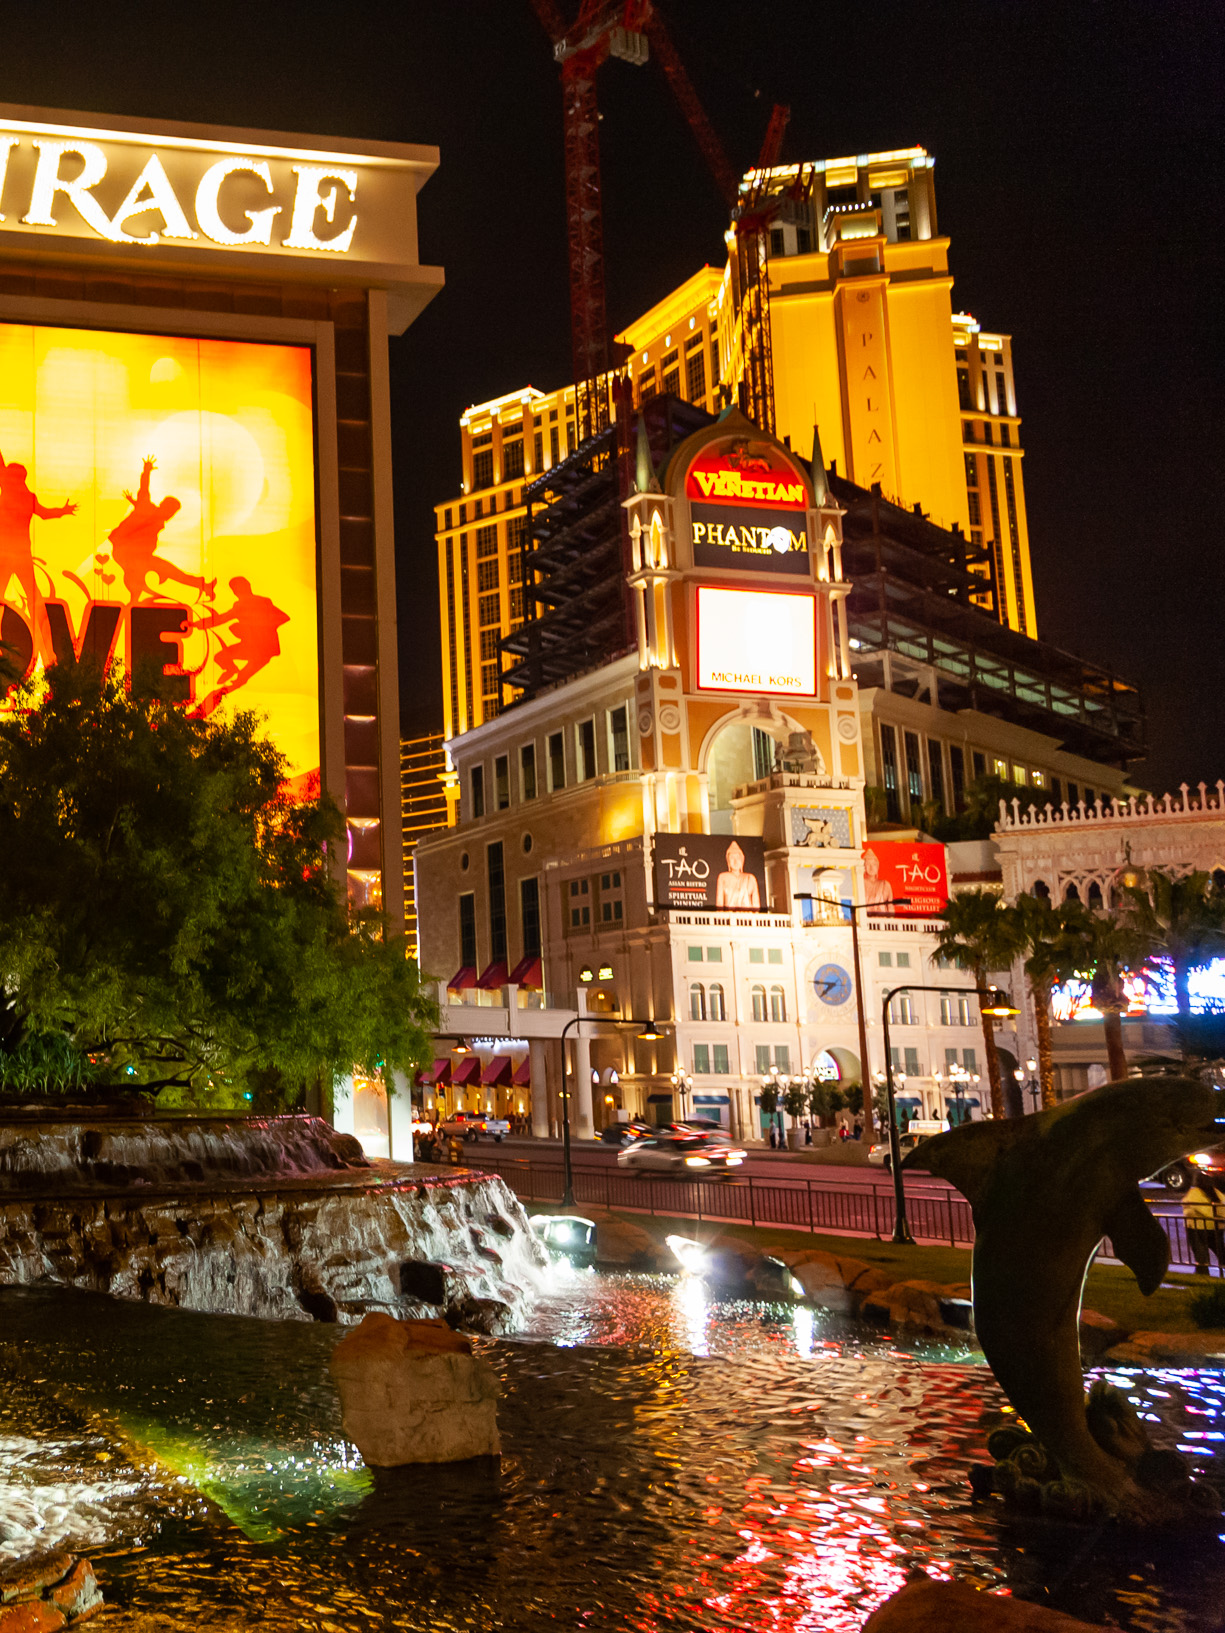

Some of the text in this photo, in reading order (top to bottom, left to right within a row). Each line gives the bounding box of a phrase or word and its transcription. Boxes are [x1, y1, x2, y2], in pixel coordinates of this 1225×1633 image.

[693, 470, 804, 503] VENETIAN
[711, 671, 802, 688] MICHAEL KORS
[660, 857, 710, 879] TAO
[895, 863, 941, 884] TAO
[668, 892, 708, 901] SPIRITUAL
[903, 896, 940, 904] LIGIOUS
